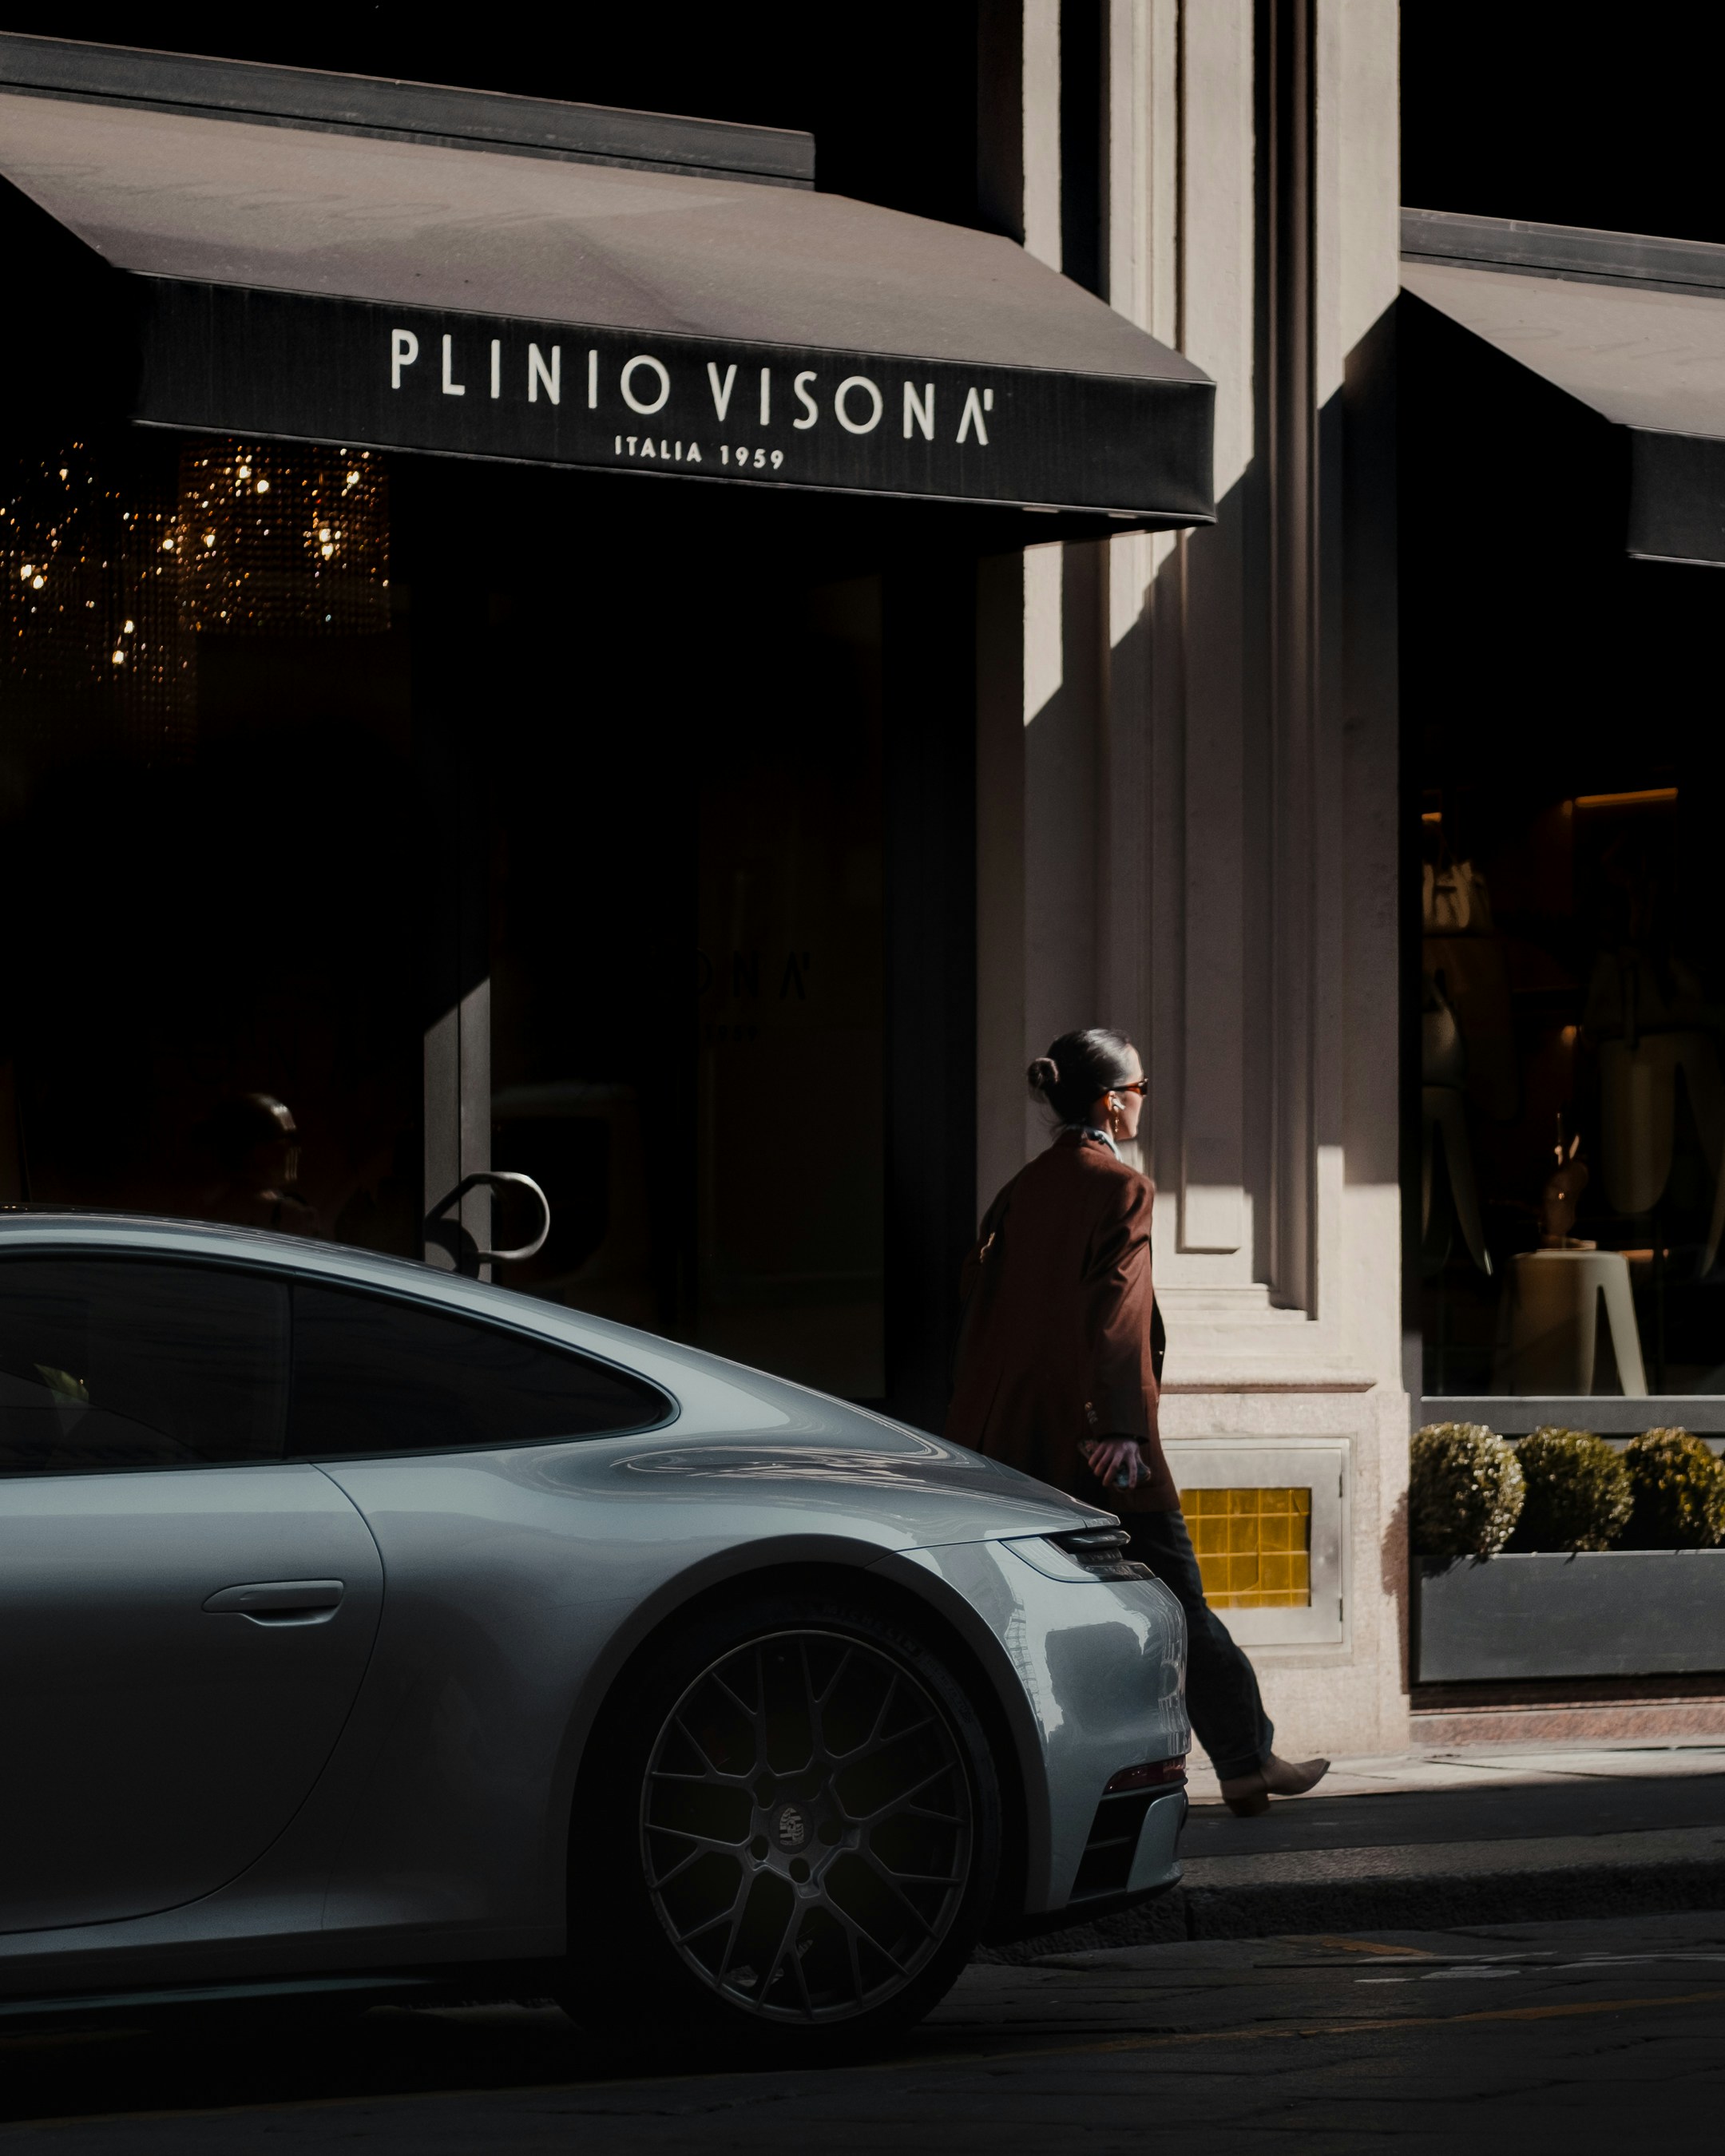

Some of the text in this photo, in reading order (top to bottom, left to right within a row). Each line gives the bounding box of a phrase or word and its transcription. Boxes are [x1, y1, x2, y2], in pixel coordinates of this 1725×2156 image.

[391, 328, 670, 415] PLINIO
[614, 435, 783, 470] ITALIA 1959
